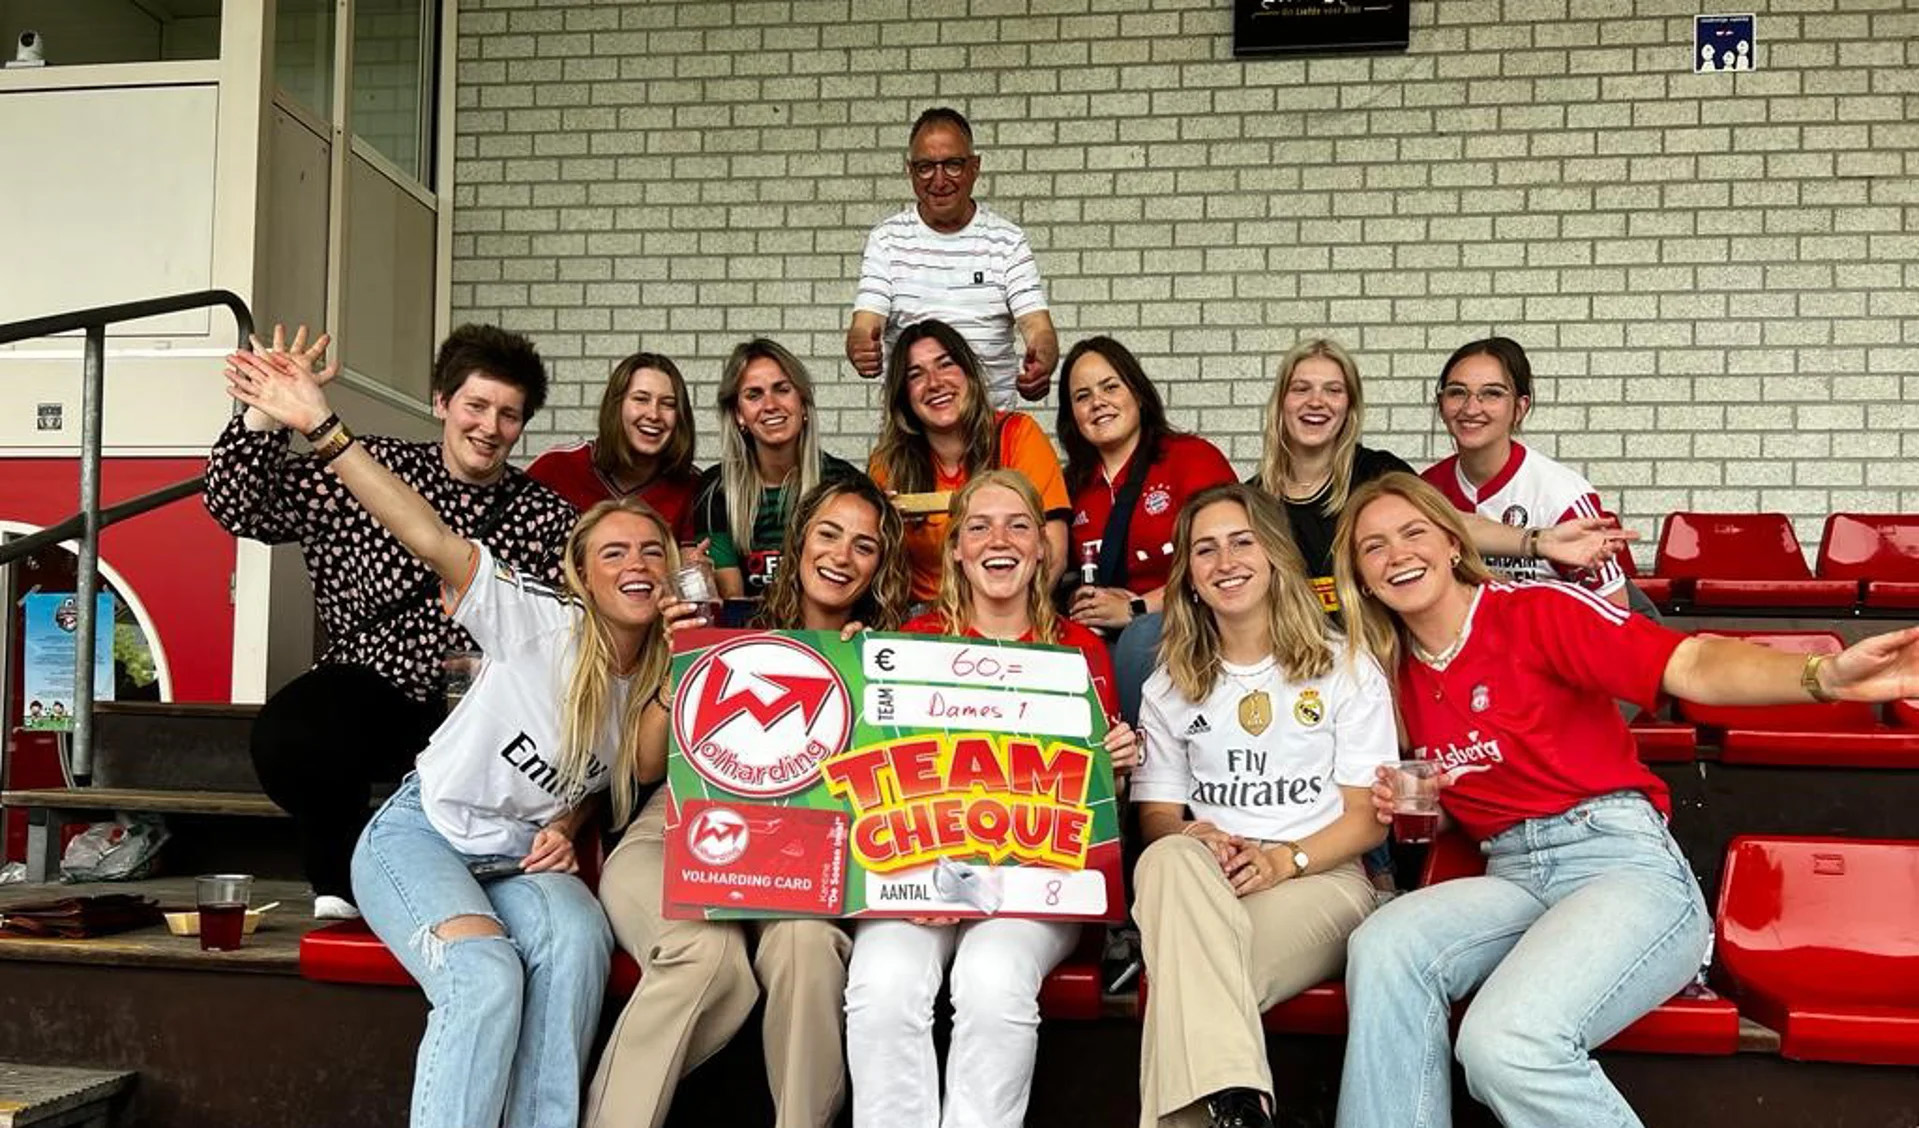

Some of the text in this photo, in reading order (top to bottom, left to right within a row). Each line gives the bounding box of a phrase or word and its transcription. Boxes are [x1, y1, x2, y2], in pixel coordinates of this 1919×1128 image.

[874, 648, 895, 672] €
[877, 688, 894, 721] TEAM
[928, 691, 1002, 718] Dames
[825, 738, 1090, 810] TEAM
[1227, 749, 1267, 776] Fly
[855, 798, 1090, 862] CHEQUE
[681, 869, 813, 890] VOLHARDING CARD
[880, 884, 931, 900] AANTAL
[1045, 880, 1062, 906] 8
